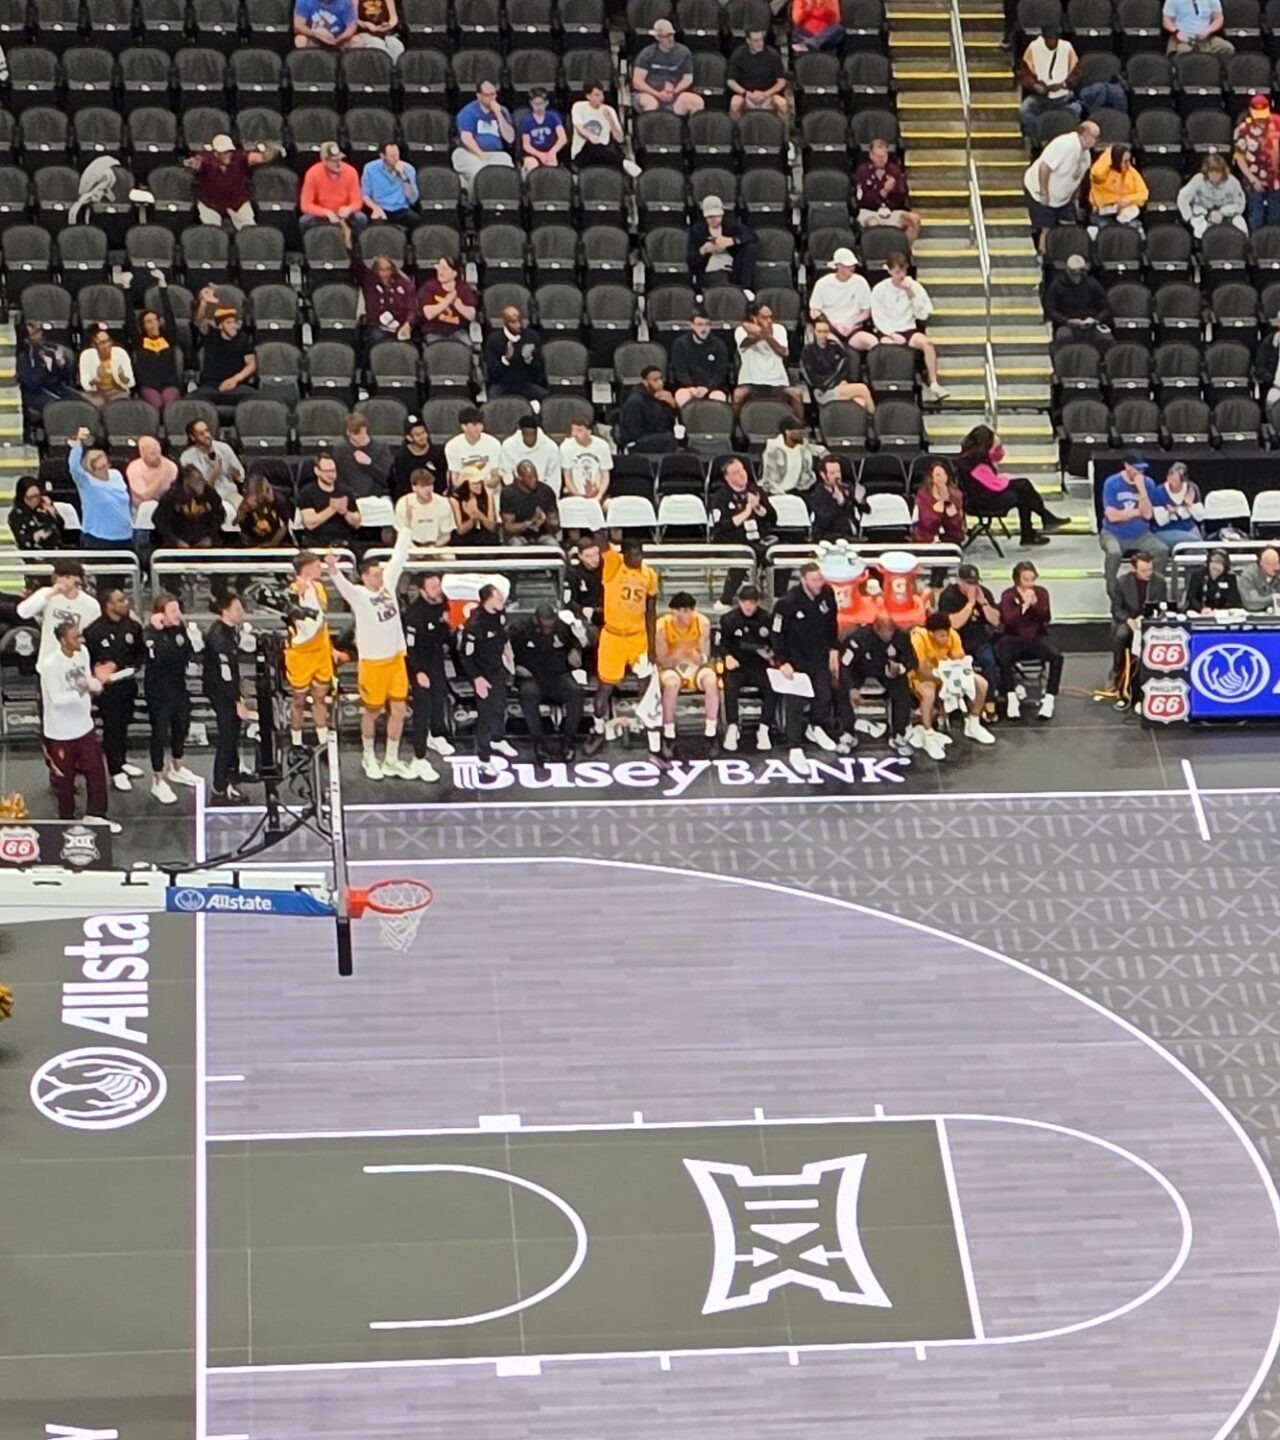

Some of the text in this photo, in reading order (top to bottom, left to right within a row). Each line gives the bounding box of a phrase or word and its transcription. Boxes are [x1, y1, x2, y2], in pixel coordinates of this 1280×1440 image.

[1151, 645, 1181, 663] 66
[1151, 696, 1181, 714] 66
[5, 841, 31, 855] 66
[207, 894, 272, 911] Allstate
